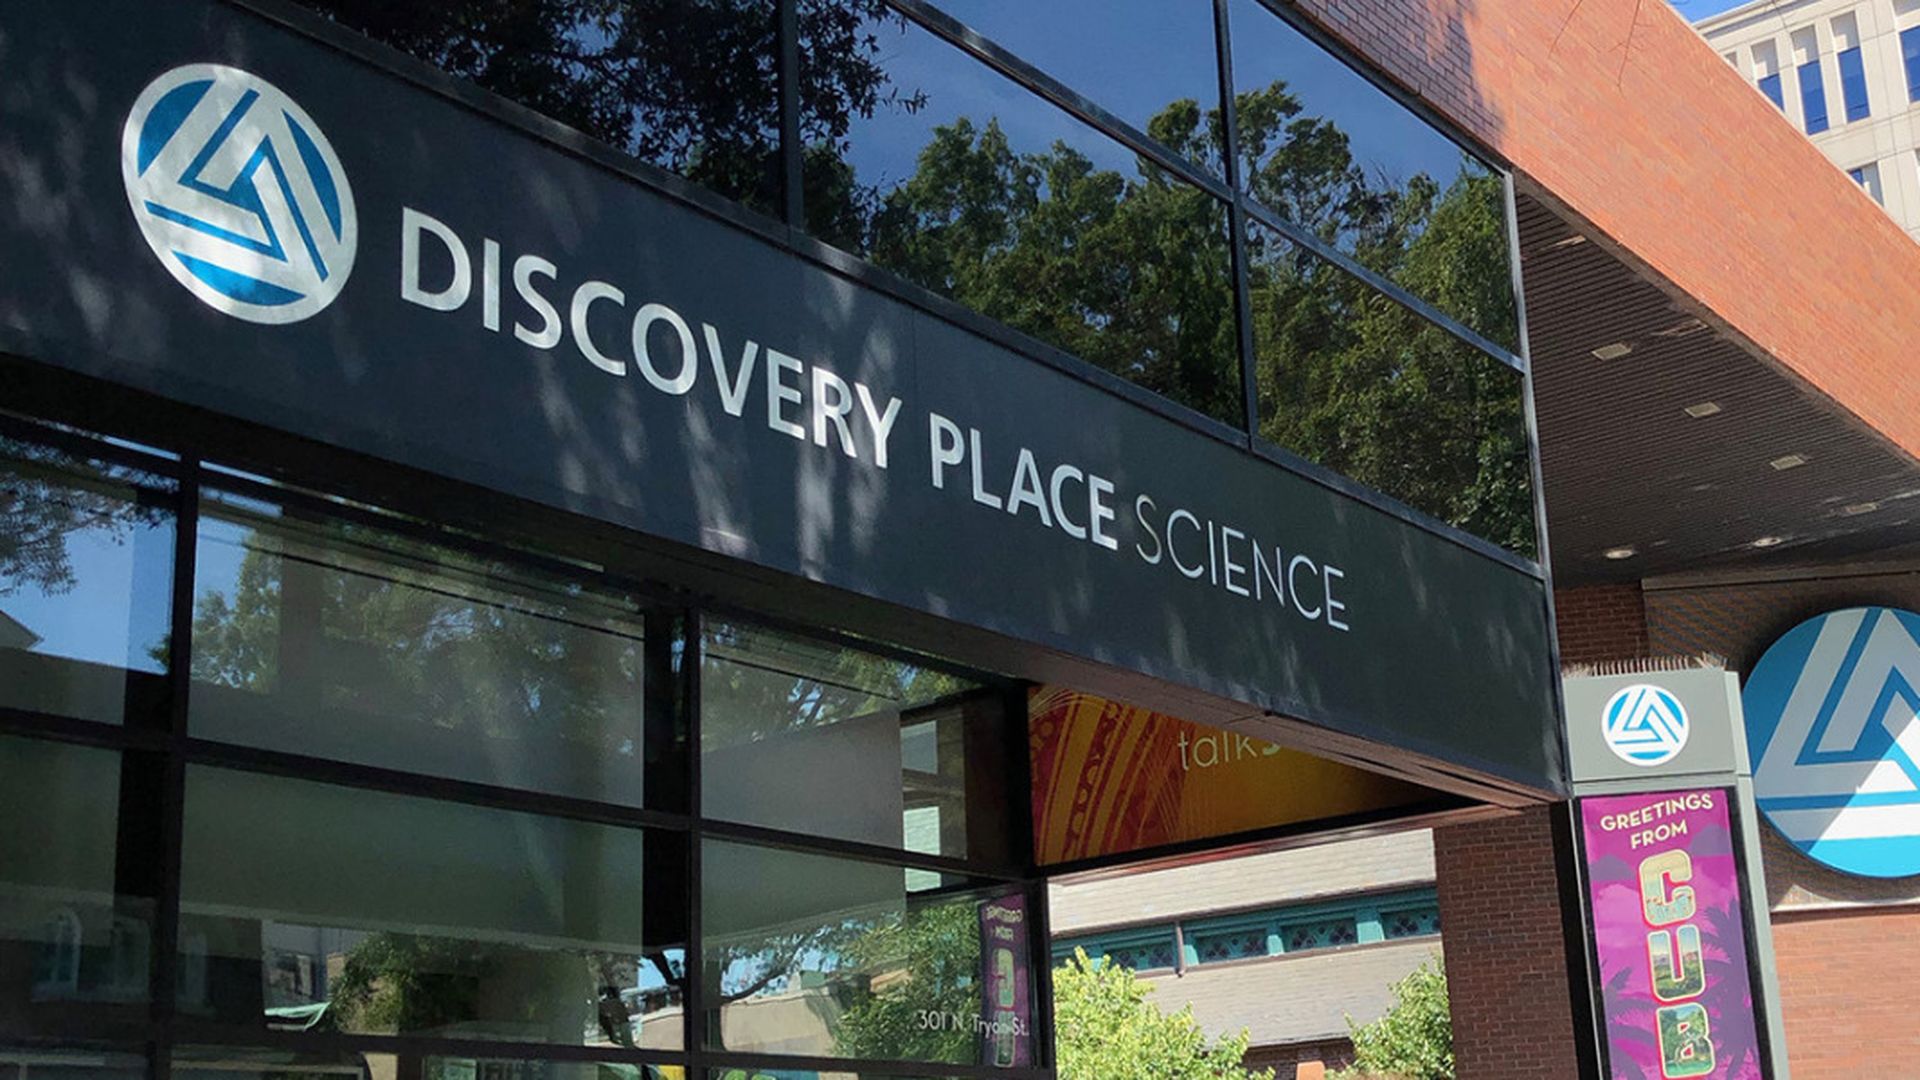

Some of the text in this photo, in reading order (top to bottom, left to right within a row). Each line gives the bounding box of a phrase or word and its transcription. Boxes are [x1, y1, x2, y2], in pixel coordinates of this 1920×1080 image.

[401, 206, 1350, 631] DISCOVERY PLACE SCIENCE
[1600, 792, 1714, 831] GREETINGS
[1630, 819, 1688, 849] FROM
[918, 1009, 947, 1030] 301
